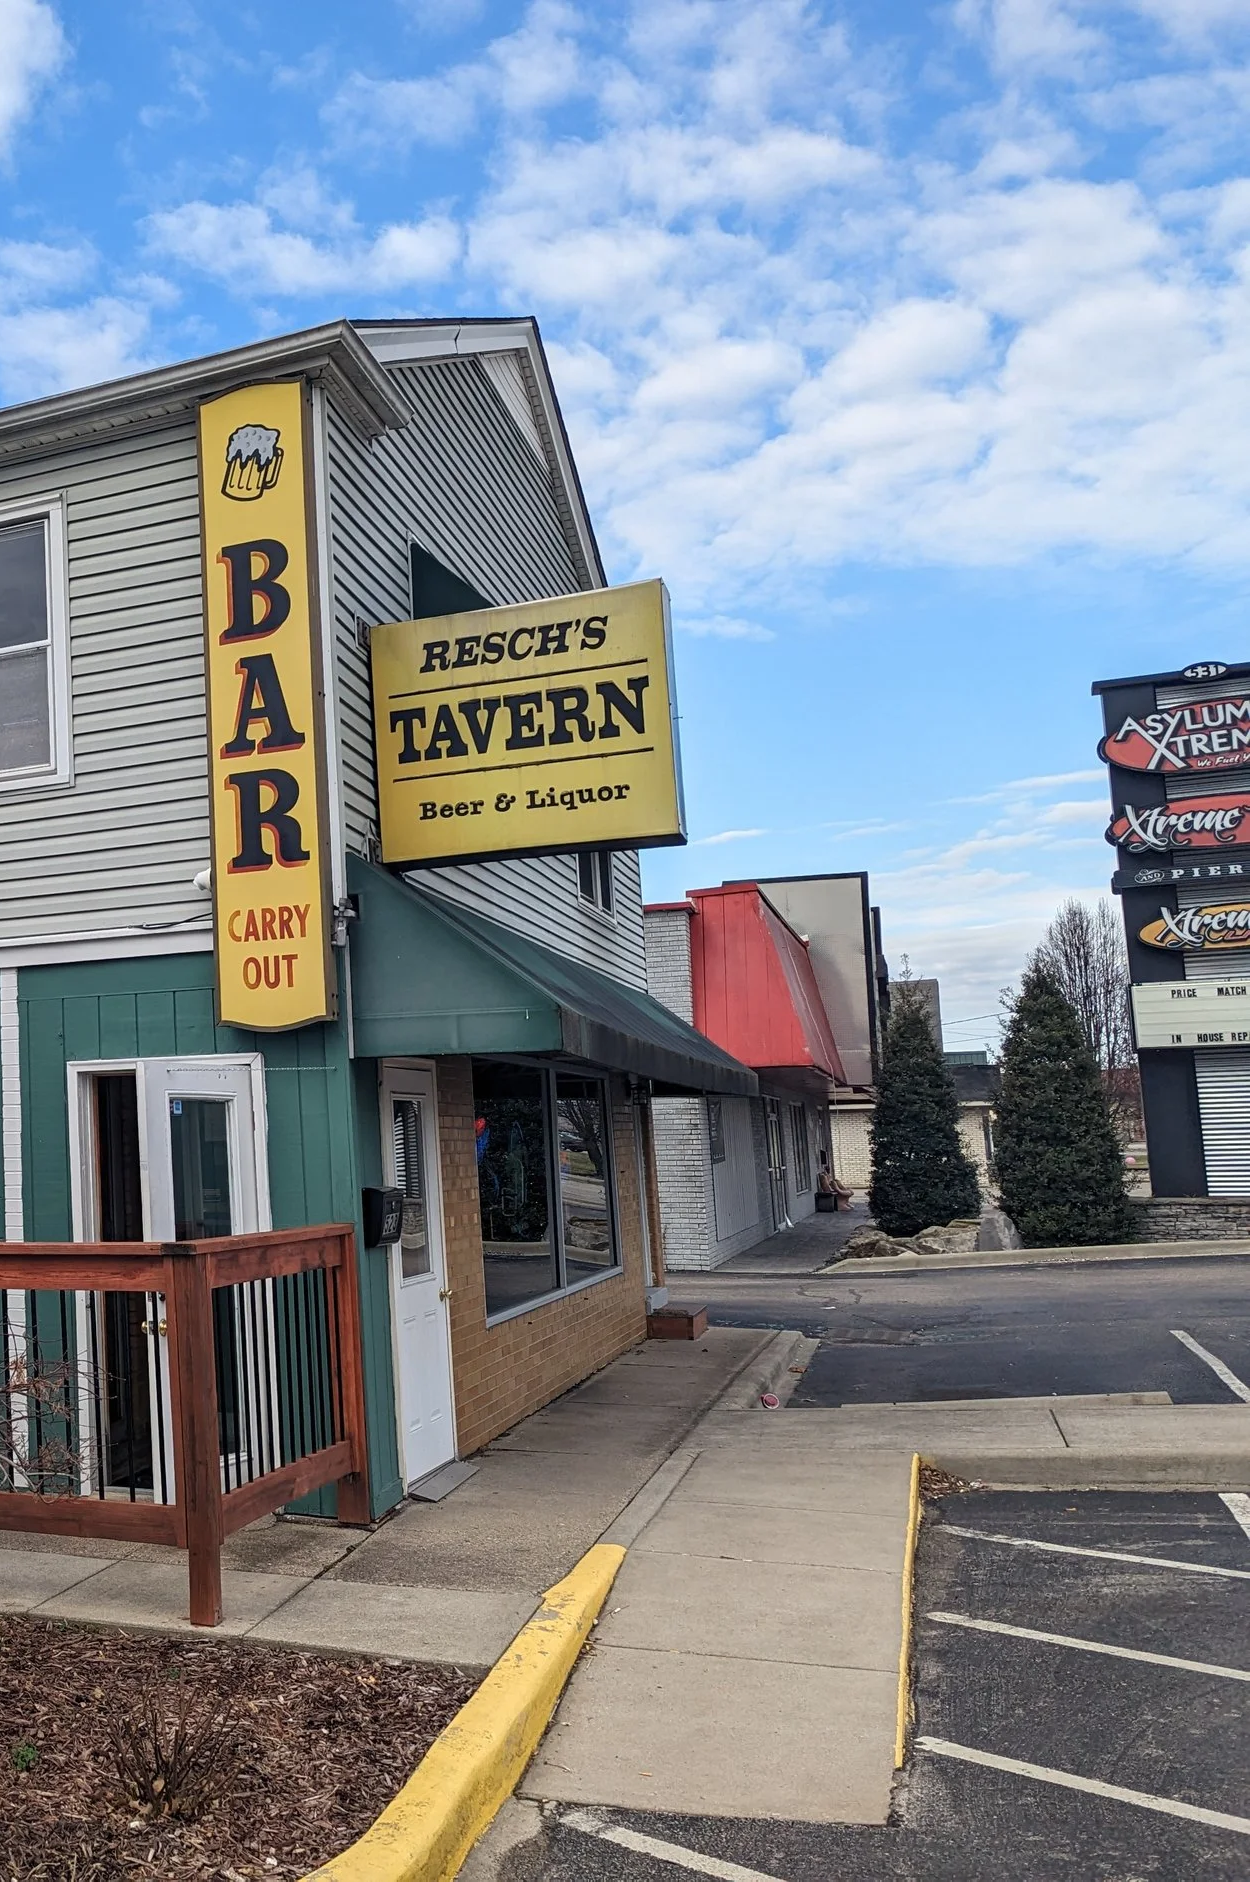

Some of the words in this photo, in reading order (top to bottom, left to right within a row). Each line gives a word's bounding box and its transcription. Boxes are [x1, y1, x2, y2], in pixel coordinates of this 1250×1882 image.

[419, 615, 608, 674] RESCH'S
[216, 538, 310, 874] BAR
[389, 675, 649, 765] TAVERN
[1115, 700, 1250, 742] ASYLUM
[1197, 759, 1212, 767] We
[1215, 754, 1240, 765] Fuel
[419, 799, 484, 821] Beer
[494, 792, 517, 812] &
[526, 783, 630, 810] Liquor
[1117, 804, 1243, 851] Xtreme
[1140, 872, 1161, 881] AND
[1171, 864, 1244, 879] PIER
[228, 903, 311, 942] CARRY
[243, 954, 298, 990] OUT
[1171, 988, 1198, 999] PRICE
[1217, 986, 1247, 997] MATCH
[1171, 1034, 1182, 1044] IN
[1197, 1032, 1224, 1043] HOUSE
